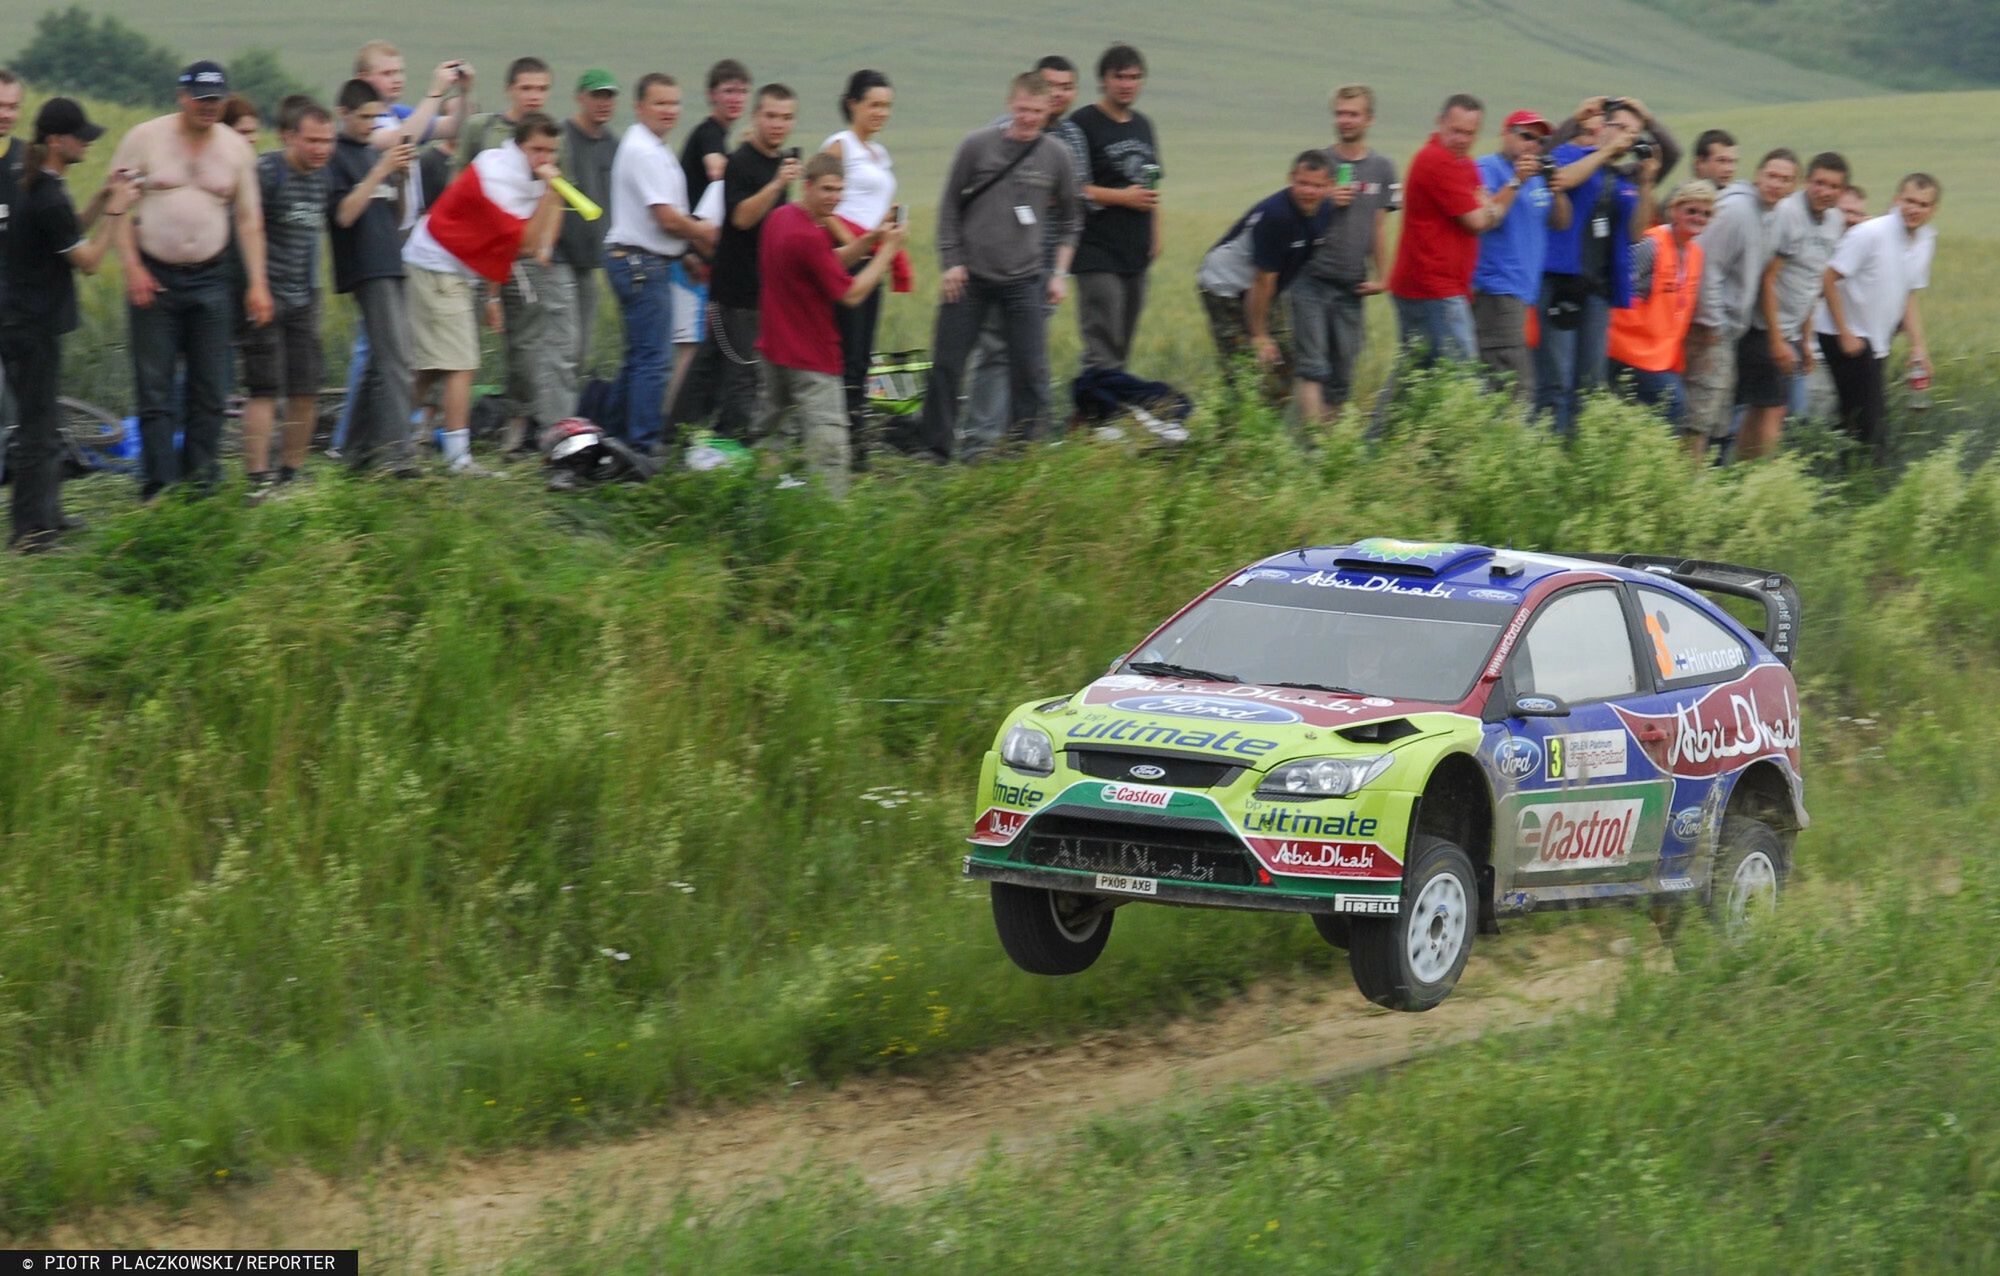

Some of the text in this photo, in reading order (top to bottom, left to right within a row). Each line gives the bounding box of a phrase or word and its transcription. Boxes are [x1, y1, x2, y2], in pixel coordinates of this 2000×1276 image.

[1688, 646, 1746, 672] Hirvonen
[1136, 697, 1267, 720] Ford
[1067, 719, 1279, 757] ultimate
[1501, 743, 1532, 774] Ford
[1551, 739, 1562, 777] 3
[1116, 787, 1168, 806] Castrol
[1243, 807, 1378, 837] ultimate
[1540, 808, 1633, 863] Castrol
[1101, 875, 1151, 892] PX08 AXB
[1334, 893, 1400, 914] PIRELLI
